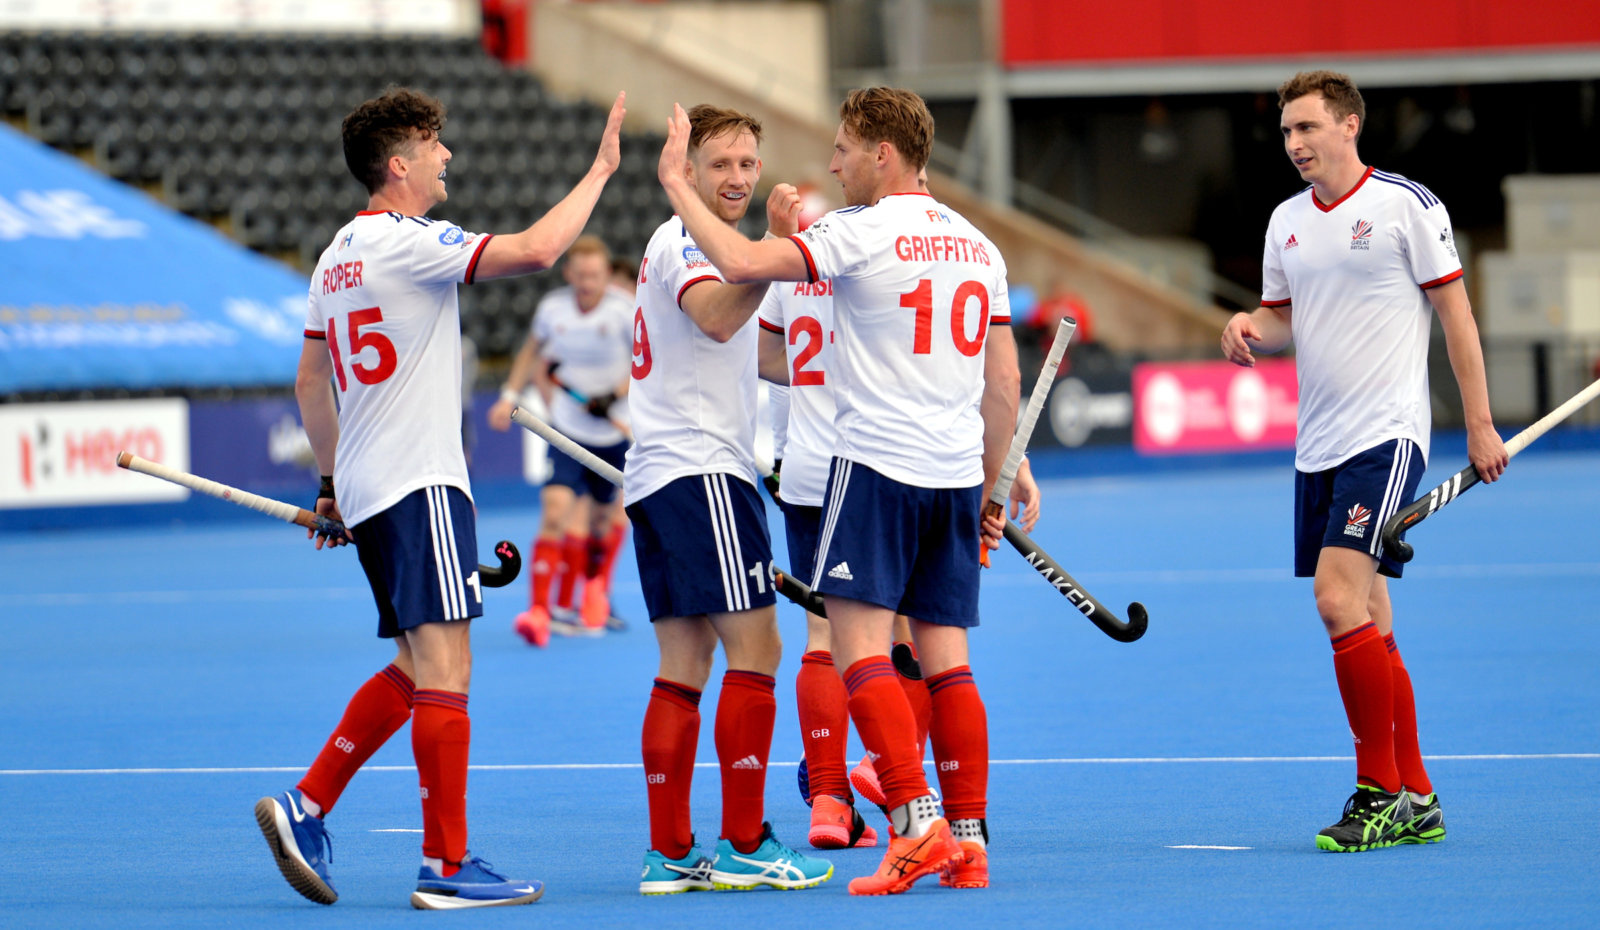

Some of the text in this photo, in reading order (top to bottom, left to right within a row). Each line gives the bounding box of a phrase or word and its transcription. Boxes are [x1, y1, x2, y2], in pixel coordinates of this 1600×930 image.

[895, 235, 991, 266] GRIFFITHS
[323, 260, 363, 296] ROPER
[900, 279, 989, 357] 10
[326, 306, 398, 392] 15
[788, 316, 835, 386] 2
[1343, 530, 1364, 539] BRITAIN
[1345, 524, 1366, 533] GREAT
[466, 571, 482, 603] 1
[828, 570, 853, 581] adidas
[1025, 551, 1096, 617] NAKED
[334, 736, 355, 754] GB
[810, 728, 830, 739] GB
[940, 760, 959, 771] GB
[648, 773, 666, 784] GB
